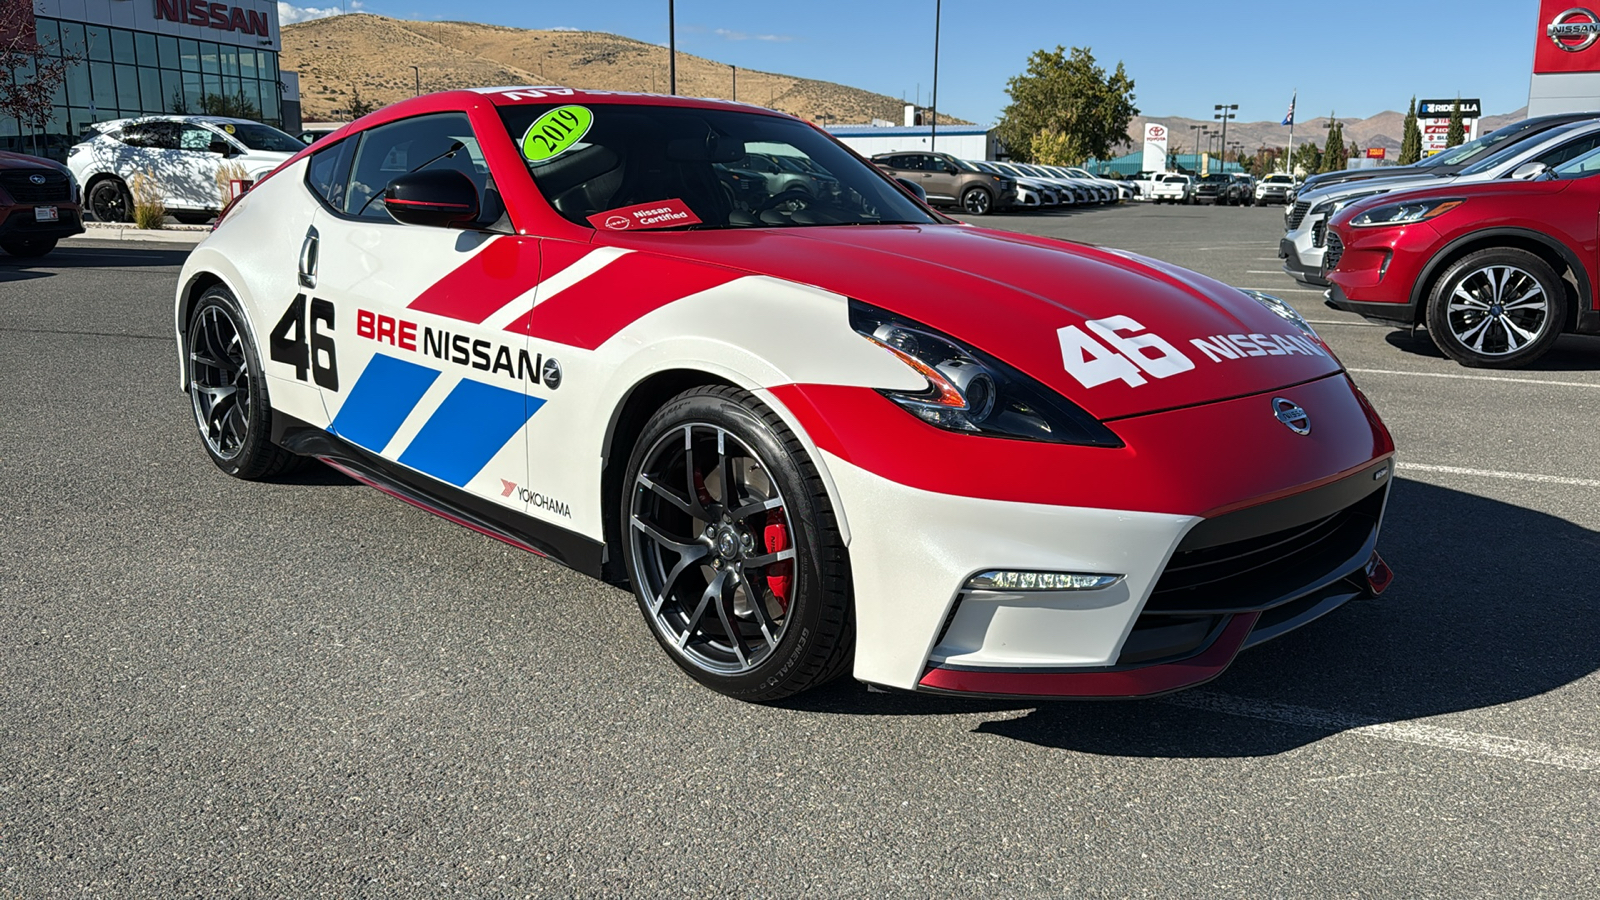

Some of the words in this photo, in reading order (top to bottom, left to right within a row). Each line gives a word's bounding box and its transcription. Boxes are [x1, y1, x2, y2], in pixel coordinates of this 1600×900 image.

[154, 0, 269, 37] NISSAN
[1552, 25, 1598, 33] NISSAN
[1435, 104, 1478, 112] RIDEILLA
[532, 109, 579, 153] 2019
[633, 206, 673, 218] Nissan
[640, 211, 688, 225] Certified
[270, 292, 339, 393] 46
[357, 308, 418, 352] BRE
[424, 327, 542, 385] NISSAN
[1056, 315, 1196, 389] 46
[1189, 333, 1326, 363] NISSAN
[517, 486, 572, 519] YOKOHAMA
[776, 627, 810, 677] GENERAL
